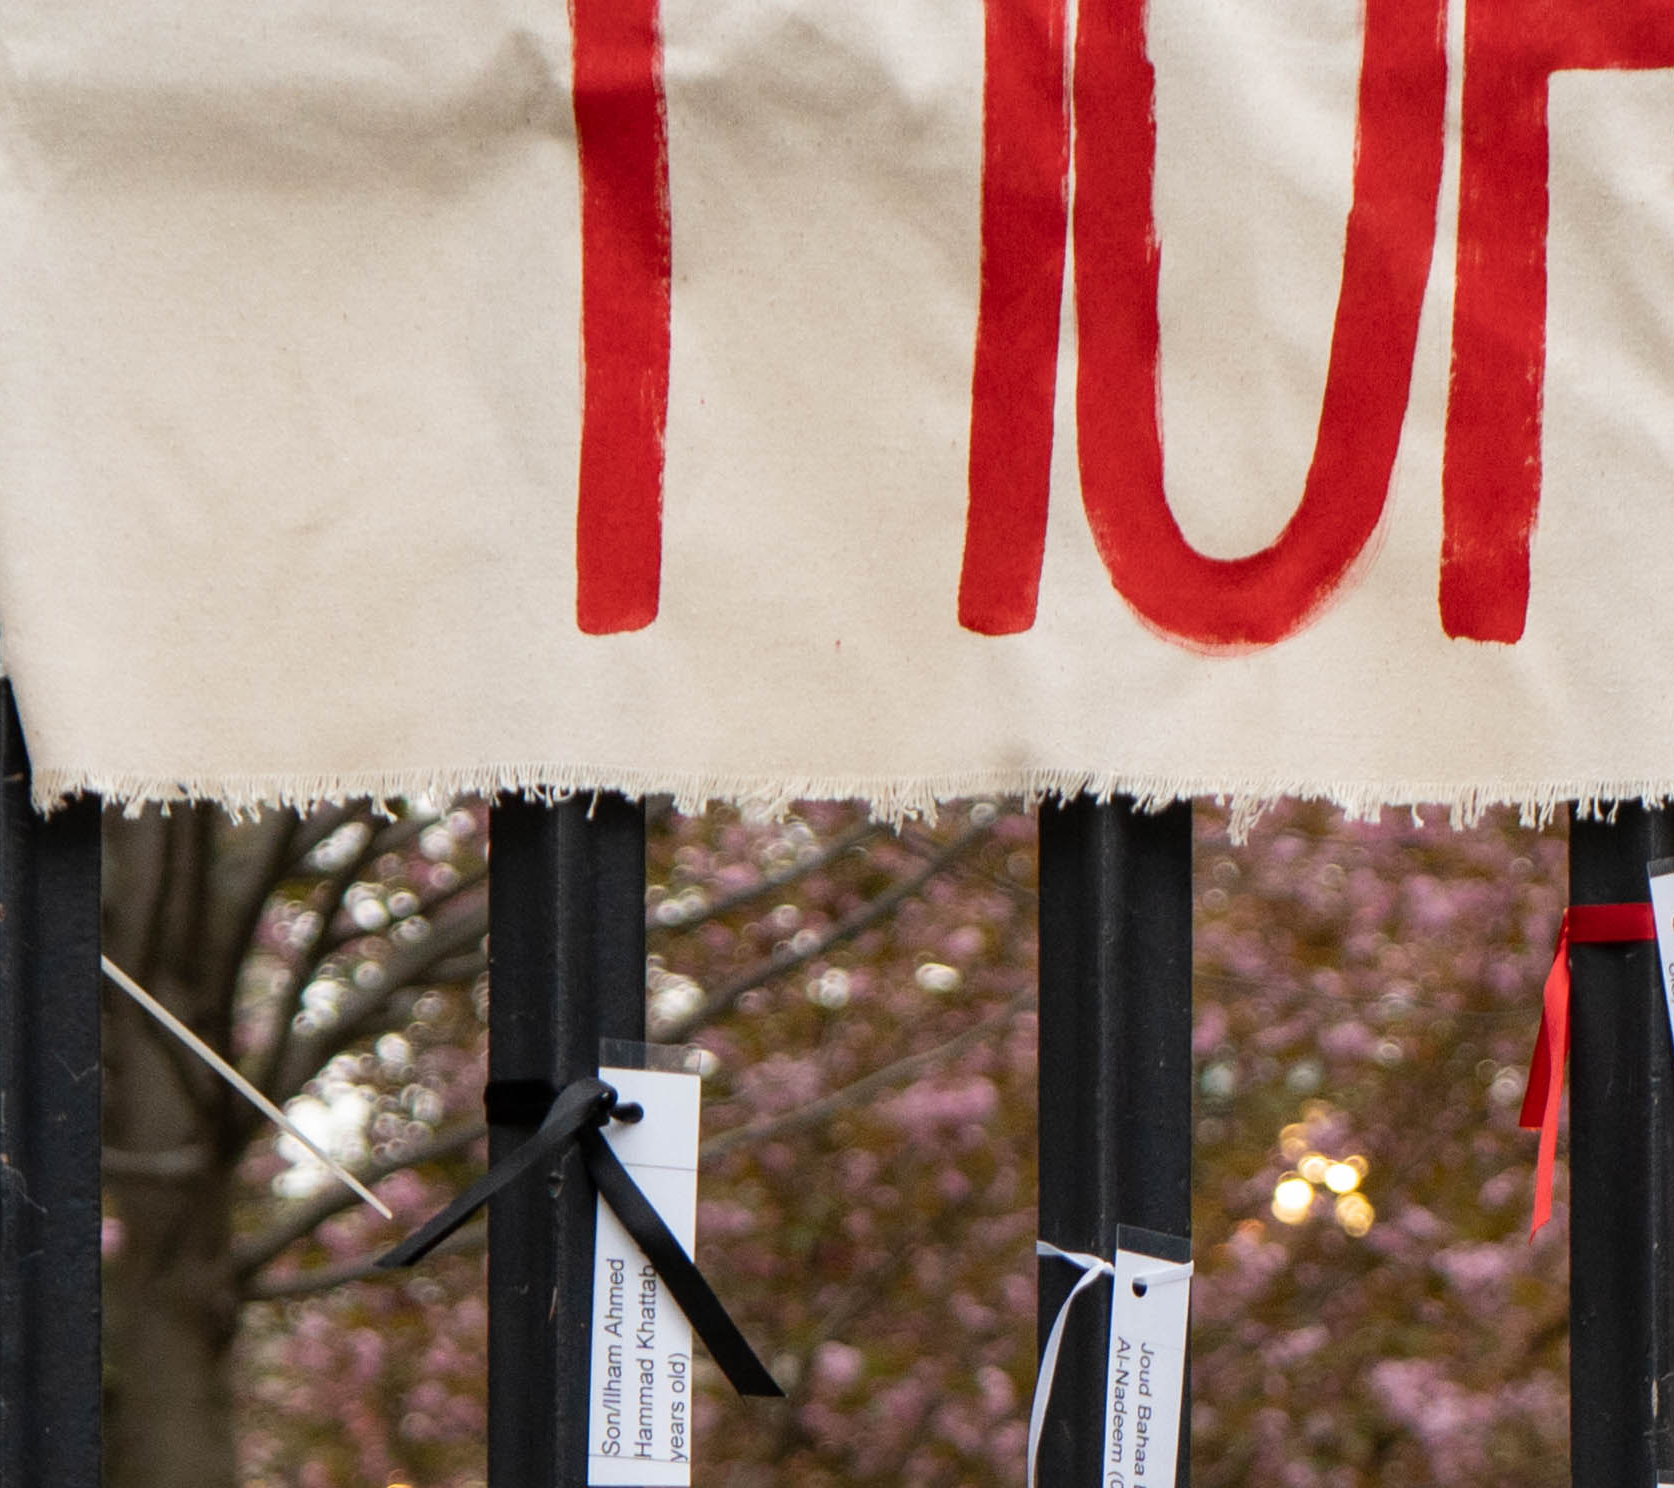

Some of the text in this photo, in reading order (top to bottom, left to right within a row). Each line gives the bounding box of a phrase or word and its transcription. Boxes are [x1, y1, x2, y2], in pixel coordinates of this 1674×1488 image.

[603, 1258, 624, 1338] Ahmed
[634, 1359, 654, 1458] Hammad
[669, 1352, 688, 1462] years old)
[1110, 1336, 1130, 1462] Al-Nadeem
[1137, 1342, 1155, 1397] Joud
[1133, 1405, 1152, 1475] Bahaa
